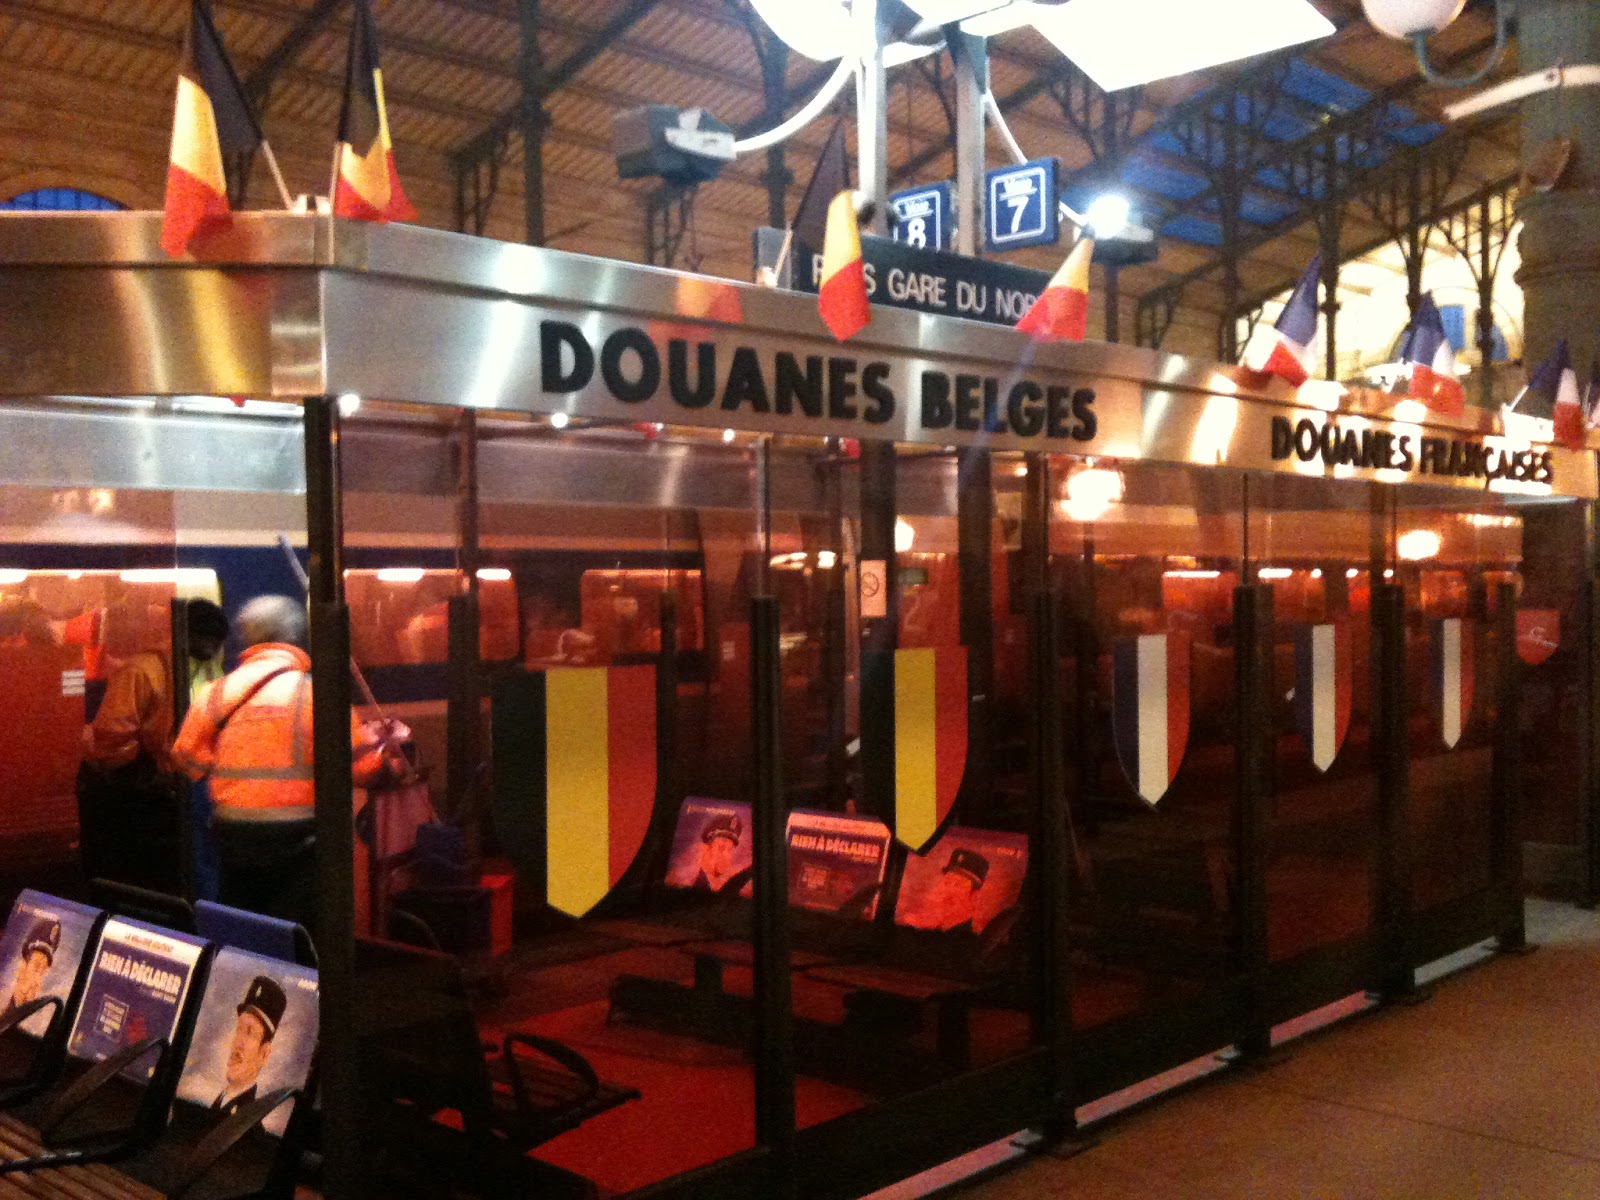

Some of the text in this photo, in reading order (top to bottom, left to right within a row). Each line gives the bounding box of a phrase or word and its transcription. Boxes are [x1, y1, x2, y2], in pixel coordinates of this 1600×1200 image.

[907, 217, 927, 249] 8
[1007, 195, 1029, 234] 7
[887, 267, 947, 307] GARE
[955, 281, 987, 314] DU
[995, 289, 1039, 319] NOR
[539, 320, 1098, 442] DOUANES BELGES
[1271, 415, 1554, 490] DOUANES FRANÇAISES
